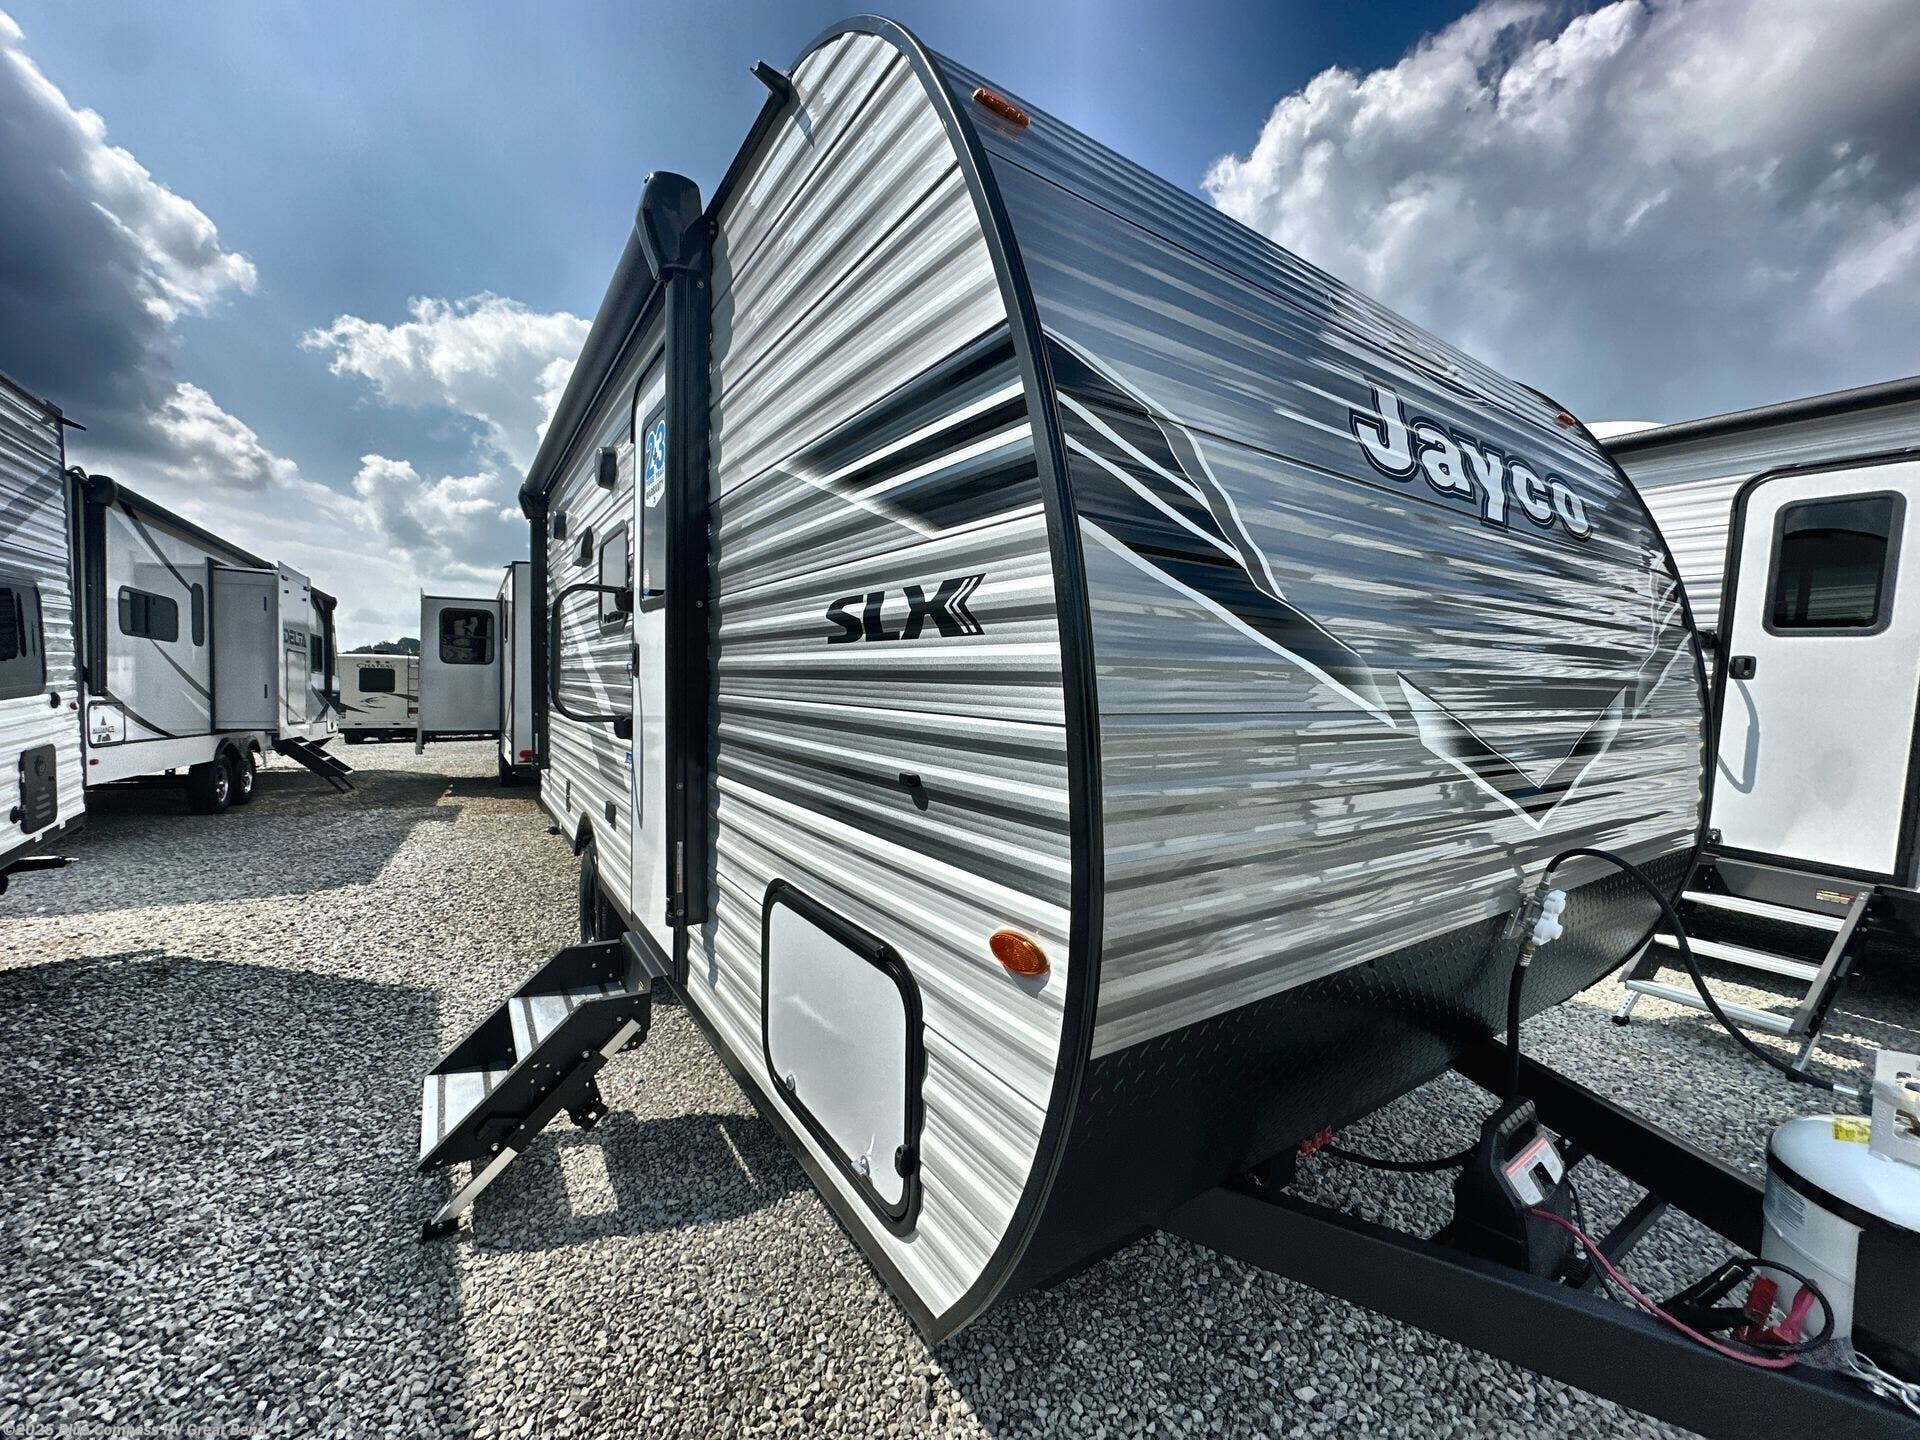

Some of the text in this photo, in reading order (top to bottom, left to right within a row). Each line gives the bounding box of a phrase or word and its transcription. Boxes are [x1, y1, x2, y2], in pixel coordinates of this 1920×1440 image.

[1350, 384, 1593, 542] Jayco
[283, 628, 307, 648] DELTA
[825, 572, 986, 644] SLX
